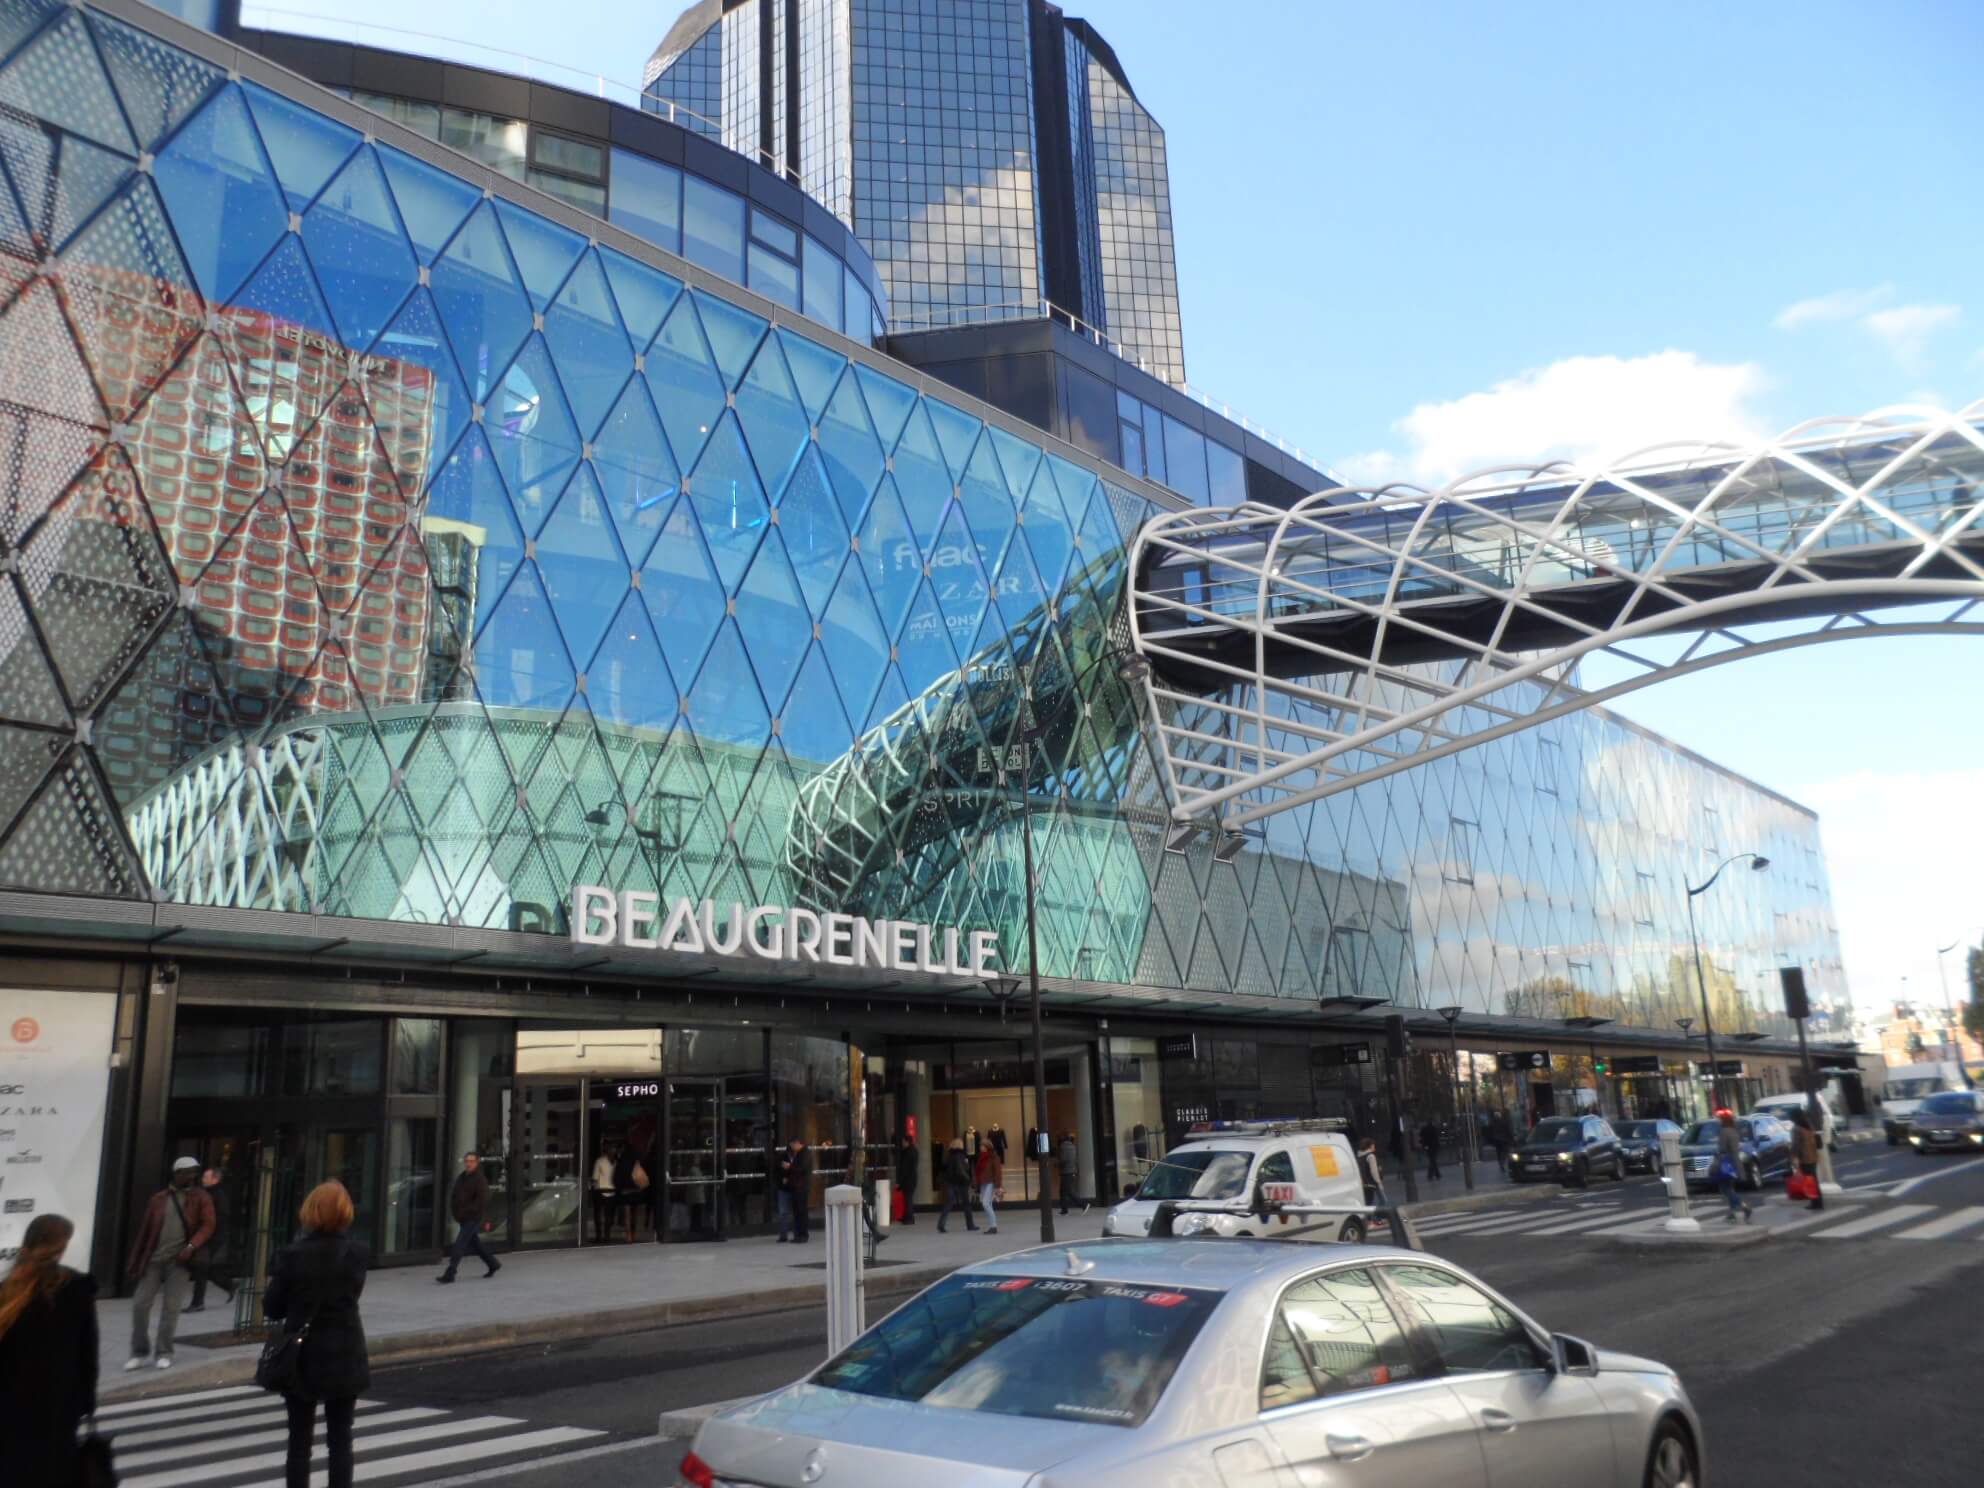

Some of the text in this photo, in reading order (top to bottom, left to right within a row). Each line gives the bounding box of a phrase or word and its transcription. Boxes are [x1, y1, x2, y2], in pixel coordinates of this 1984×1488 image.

[939, 576, 1051, 601] ZARA
[910, 614, 979, 631] MAIONS
[571, 885, 999, 978] BEAUGRENELLE
[1264, 1186, 1296, 1201] TAXI
[1103, 1286, 1146, 1299] TAXIS
